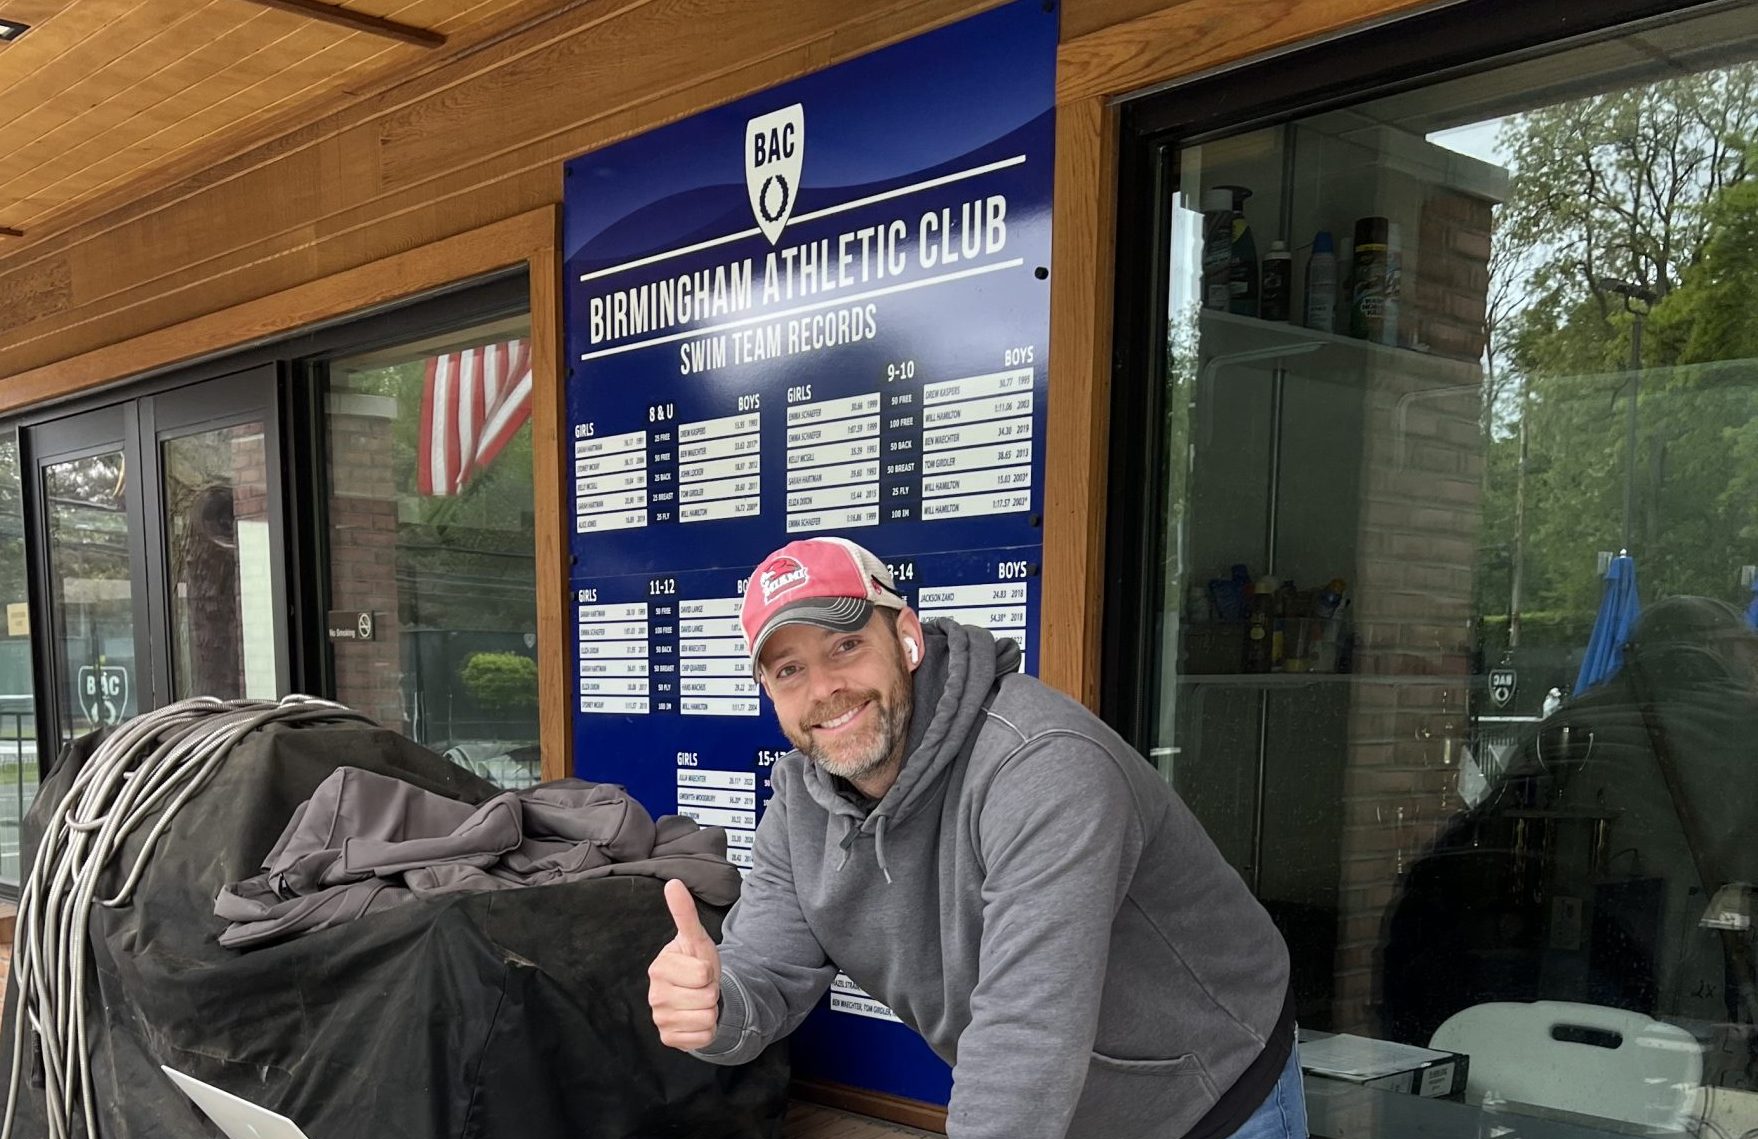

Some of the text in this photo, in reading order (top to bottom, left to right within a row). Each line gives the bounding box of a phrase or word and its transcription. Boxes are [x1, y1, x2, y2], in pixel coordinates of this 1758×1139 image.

[754, 122, 795, 168] BAC
[590, 194, 1007, 344] BIRMINGHAM ATHLETIC CLUB
[680, 303, 877, 376] SWIM TEAM RECORDS
[1004, 346, 1033, 367] BOYS
[887, 360, 915, 382] 9-10
[787, 384, 811, 403] GIRLS
[891, 394, 913, 406] 50 FREE
[738, 394, 760, 411] BOYS
[649, 403, 674, 422] 8 & U
[925, 412, 935, 422] WILL
[936, 409, 960, 421] HAMILTON
[889, 416, 914, 429] 100 FREE
[575, 423, 594, 438] GIRLS
[925, 436, 934, 445] BEN
[934, 432, 959, 444] WAECHTER
[1016, 424, 1029, 434] 2019
[890, 440, 913, 451] 50 BACK
[887, 462, 915, 474] 50 BREAST
[924, 459, 935, 468] TOM
[892, 486, 910, 496] 25 FLY
[924, 482, 934, 491] WILL
[935, 480, 959, 490] HAMILTON
[924, 505, 934, 514] WILL
[935, 503, 959, 513] HAMILTON
[887, 563, 914, 580] 3-14
[998, 561, 1027, 579] BOYS
[649, 579, 675, 596] 11-12
[578, 588, 597, 603] GIRLS
[920, 593, 942, 603] JACKSON
[1011, 589, 1024, 599] 2018
[1010, 613, 1023, 622] 2018
[336, 628, 356, 639] Smoking
[677, 752, 698, 767] GIRLS
